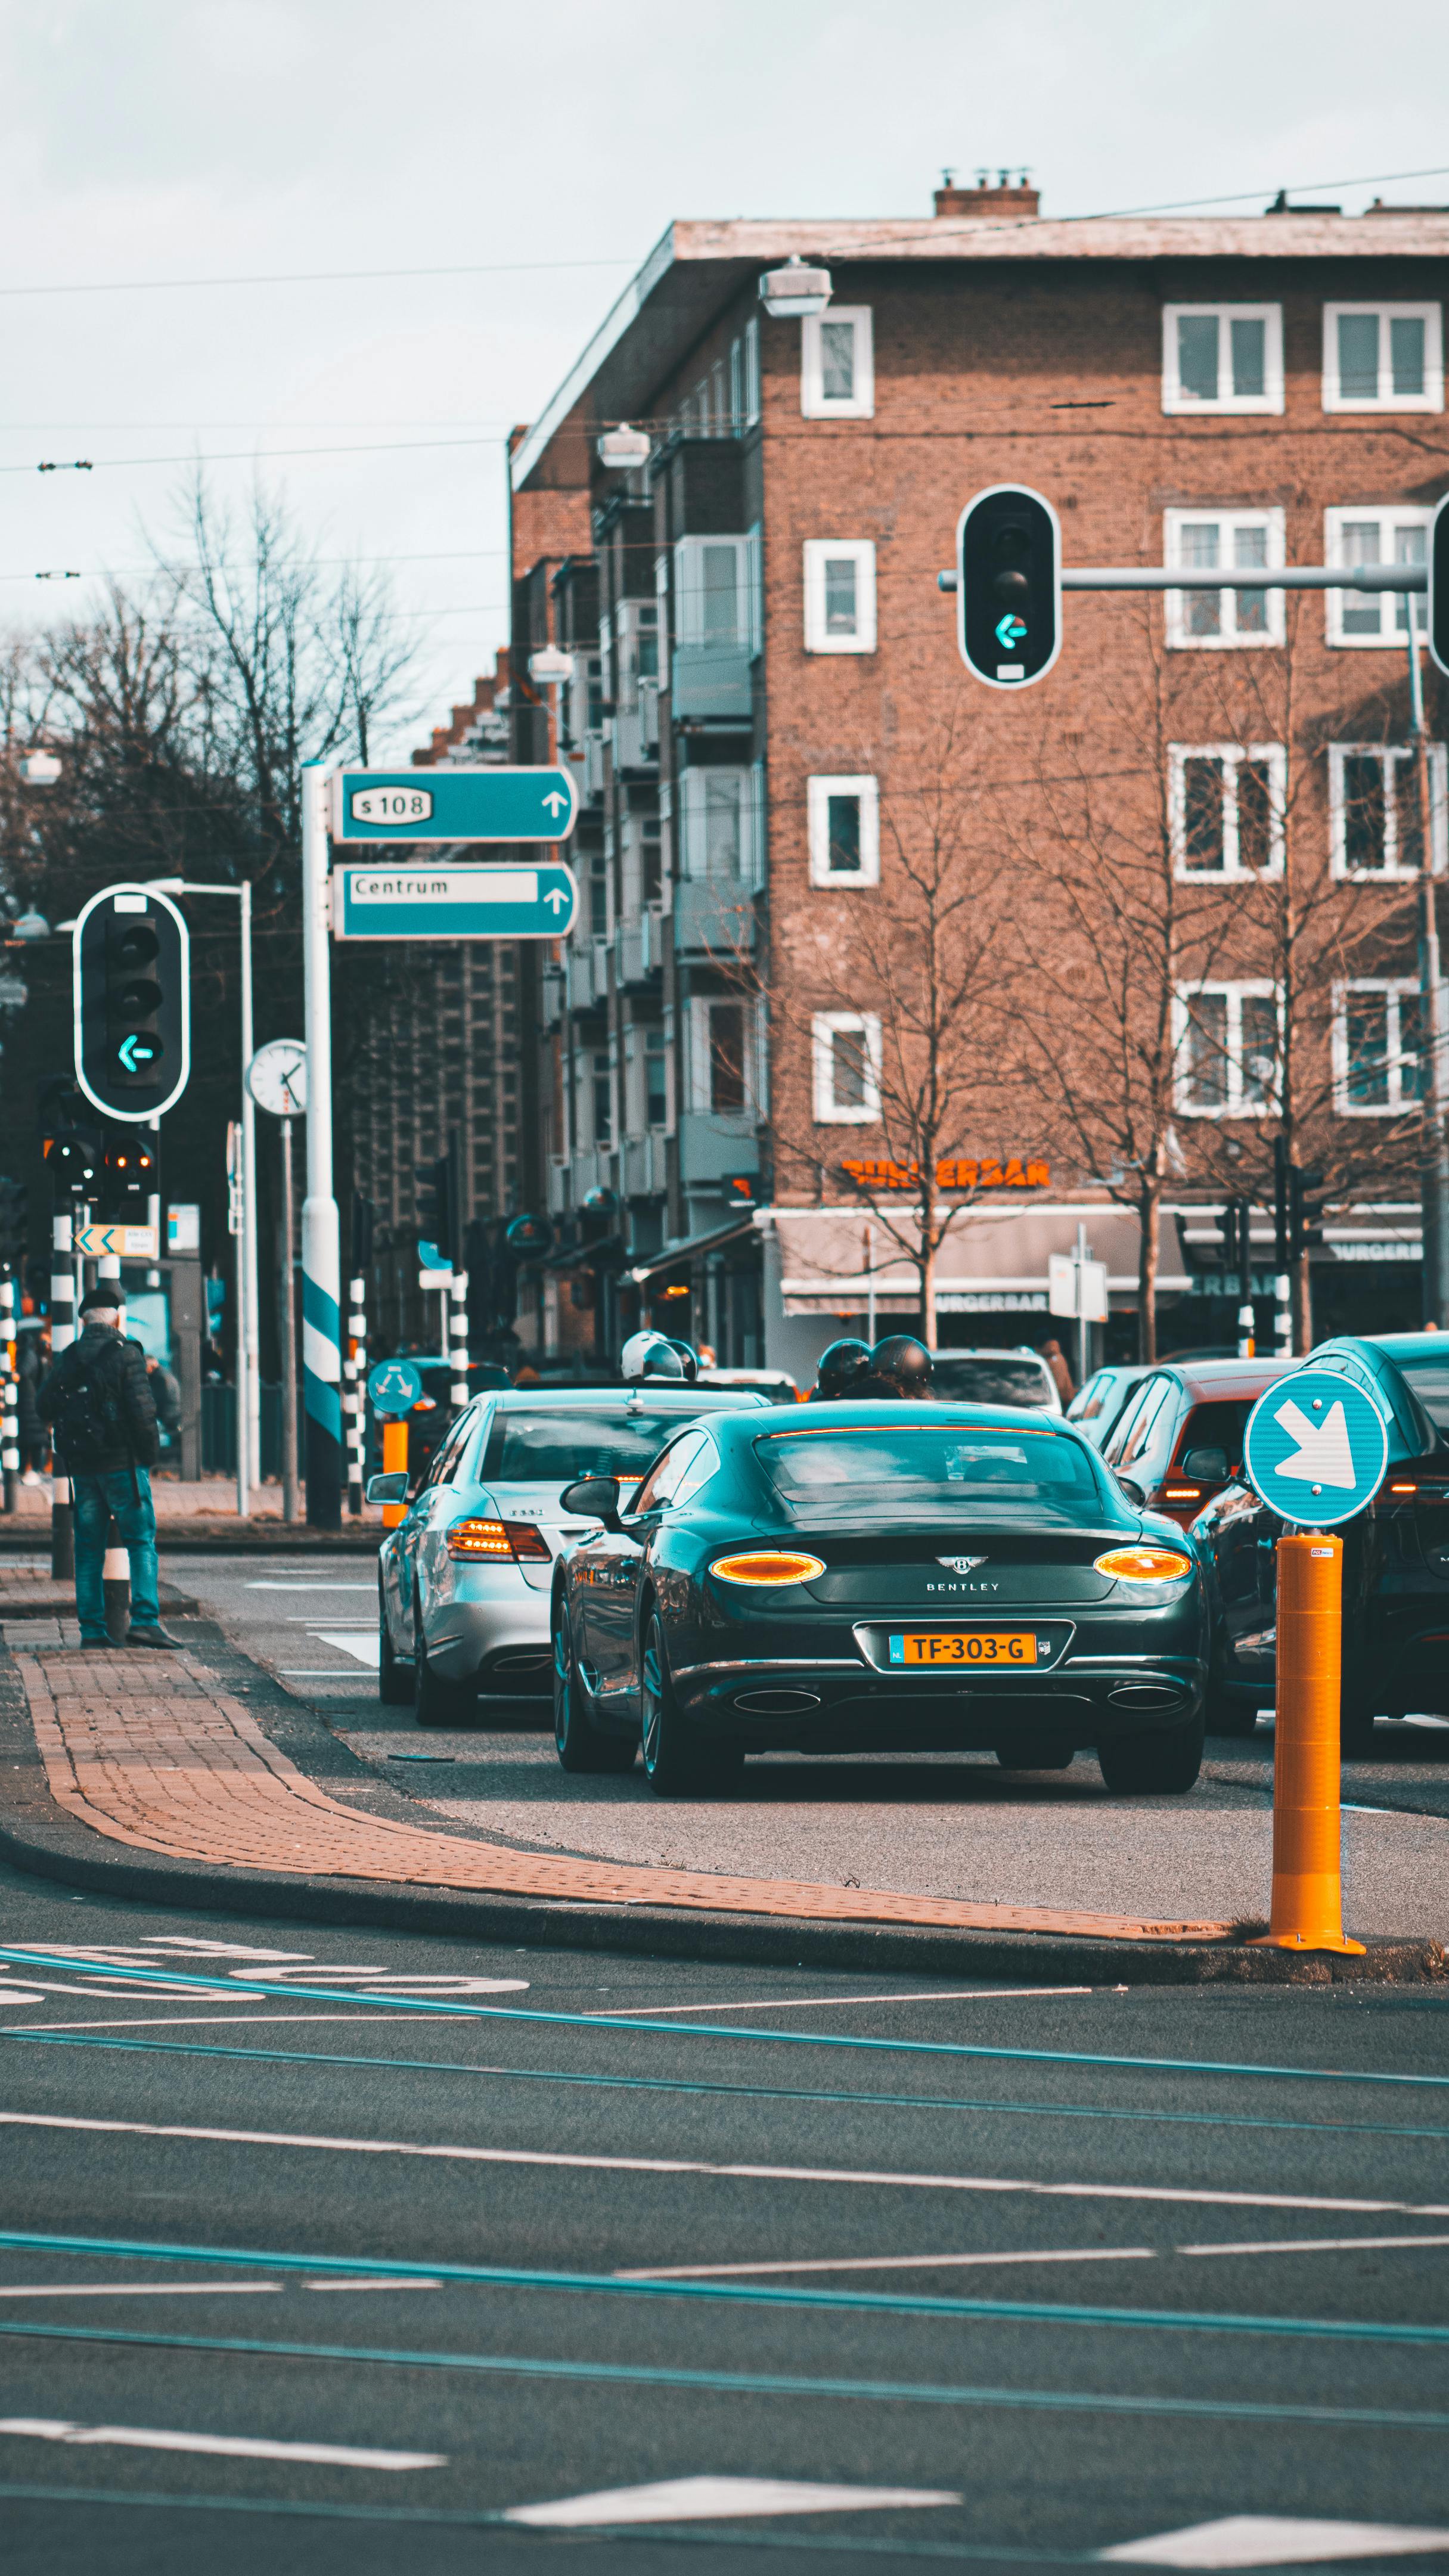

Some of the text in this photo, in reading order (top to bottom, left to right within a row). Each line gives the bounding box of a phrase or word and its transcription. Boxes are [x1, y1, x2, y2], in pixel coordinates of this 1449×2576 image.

[355, 879, 448, 894] Centrum
[842, 1159, 1050, 1187] BURERBAR
[936, 1294, 1047, 1312] URGERBAR
[913, 1638, 1023, 1659] TF-303-G
